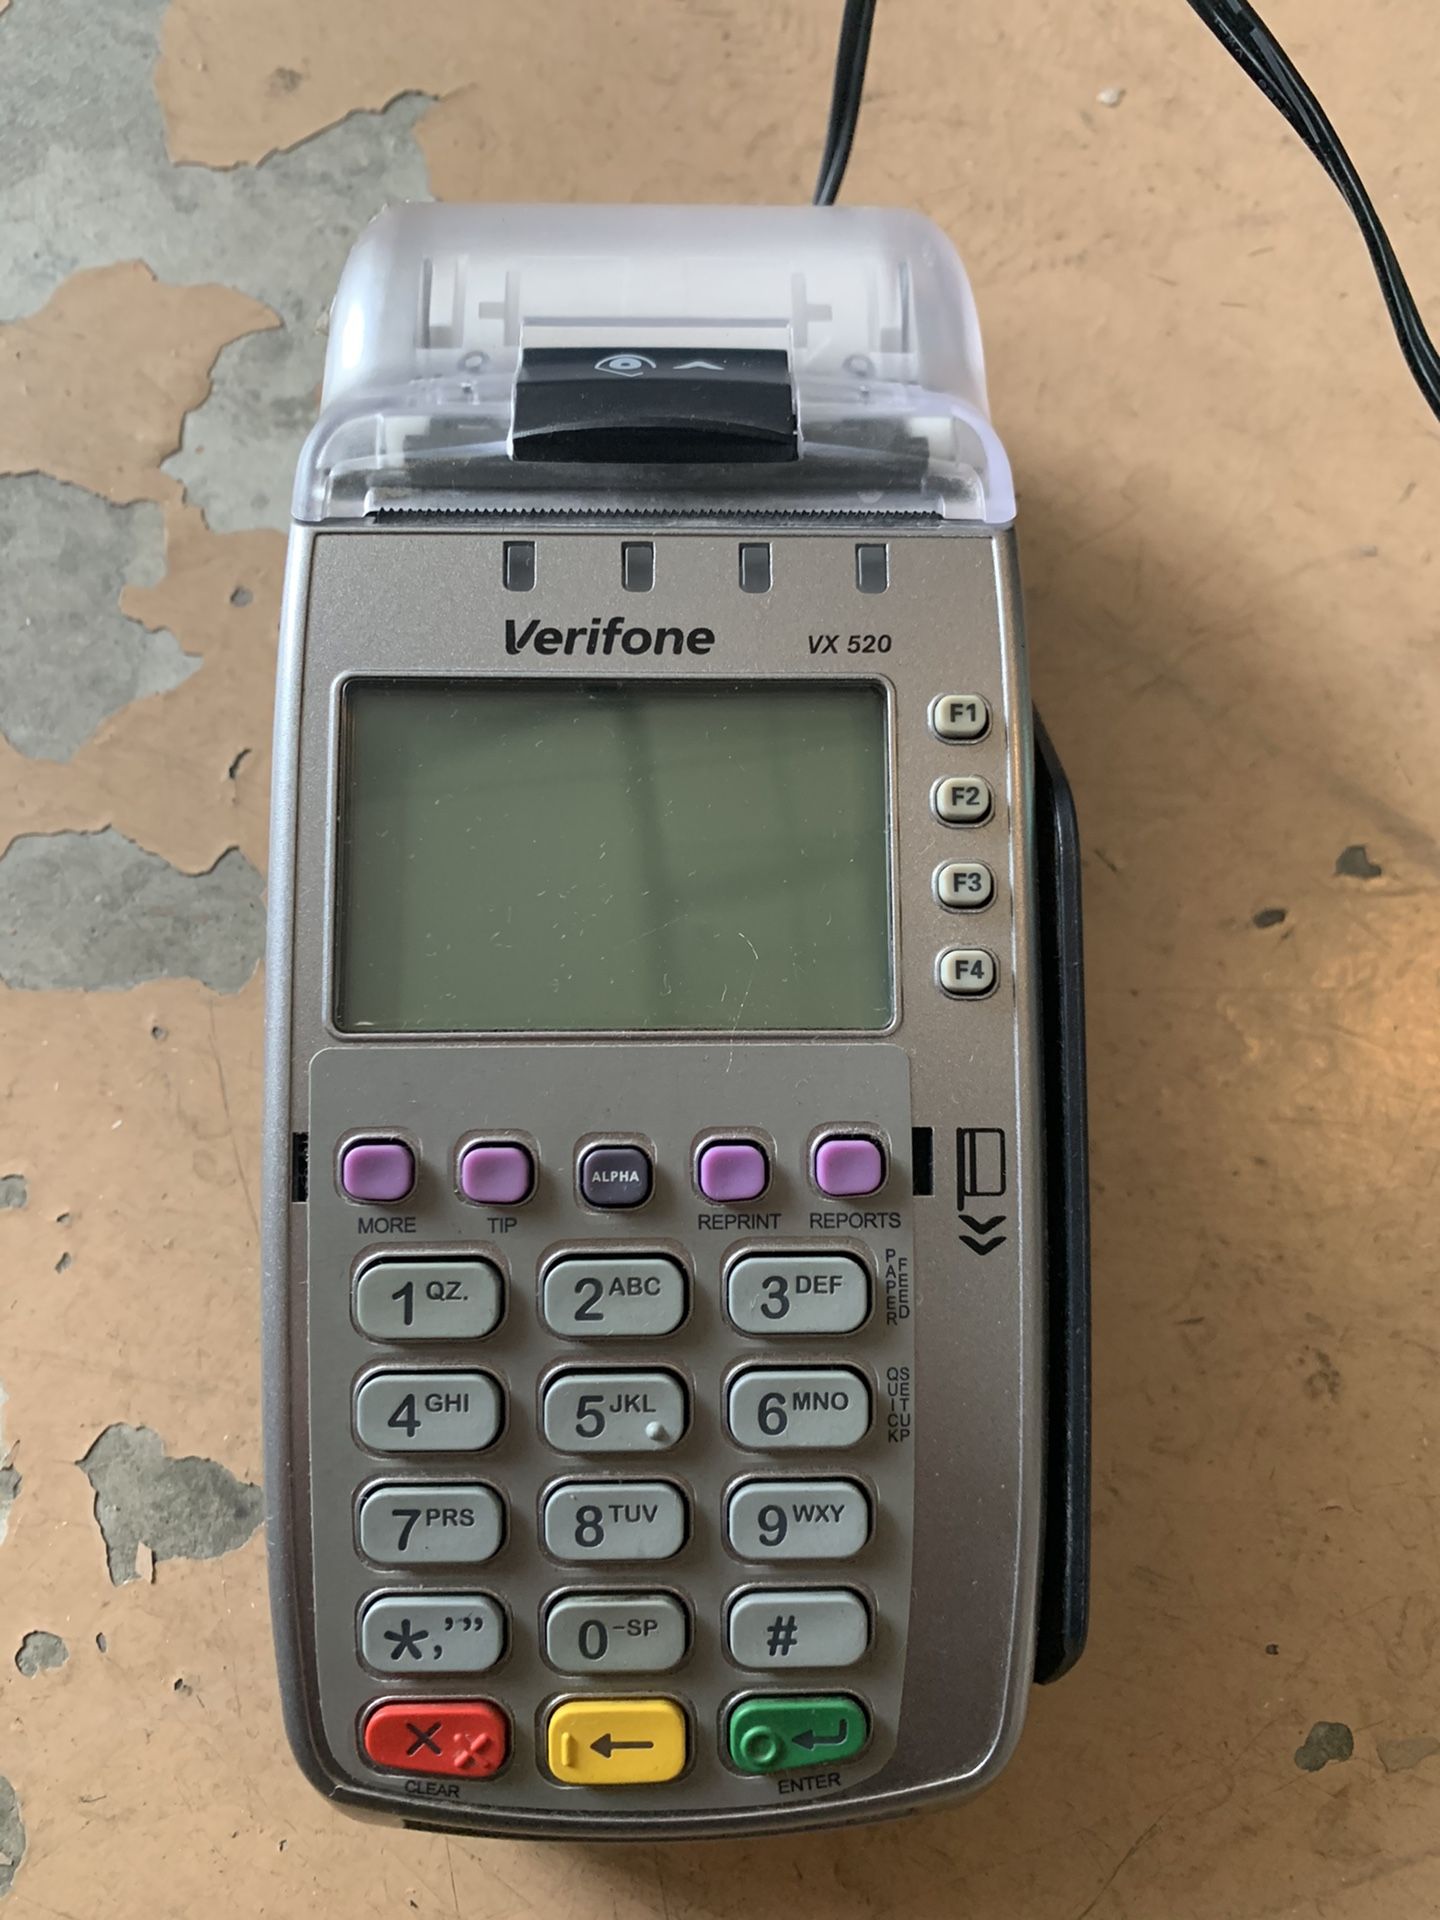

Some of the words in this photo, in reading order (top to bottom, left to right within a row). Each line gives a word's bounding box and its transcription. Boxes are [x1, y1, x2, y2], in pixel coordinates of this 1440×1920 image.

[505, 617, 716, 657] Verifone
[807, 634, 840, 655] VX
[847, 634, 892, 654] 520
[950, 703, 976, 722] F1
[951, 787, 980, 806] F2
[953, 873, 982, 892] F3
[955, 960, 984, 980] F4
[591, 1170, 640, 1184] ALPHA
[357, 1217, 417, 1234] MORE
[487, 1217, 518, 1234] TIP
[697, 1213, 782, 1231] REPRINT
[810, 1212, 902, 1229] REPORTS
[391, 1281, 415, 1326] 1
[573, 1277, 605, 1321] 2
[608, 1277, 662, 1297] ABC
[760, 1275, 790, 1320] 3
[795, 1276, 843, 1294] DEF
[387, 1393, 421, 1438] 4
[424, 1394, 470, 1413] GHI
[575, 1395, 605, 1439] 5
[609, 1395, 657, 1413] JKL
[757, 1392, 788, 1436] 6
[792, 1392, 849, 1411] MNO
[391, 1508, 422, 1551] 7
[425, 1508, 475, 1527] PRS
[574, 1505, 604, 1548] 8
[608, 1505, 658, 1523] TUV
[757, 1504, 788, 1547] 9
[792, 1504, 845, 1523] WXY
[578, 1619, 608, 1661] 0
[404, 1779, 460, 1799] CLEAR
[777, 1772, 842, 1795] ENTER
